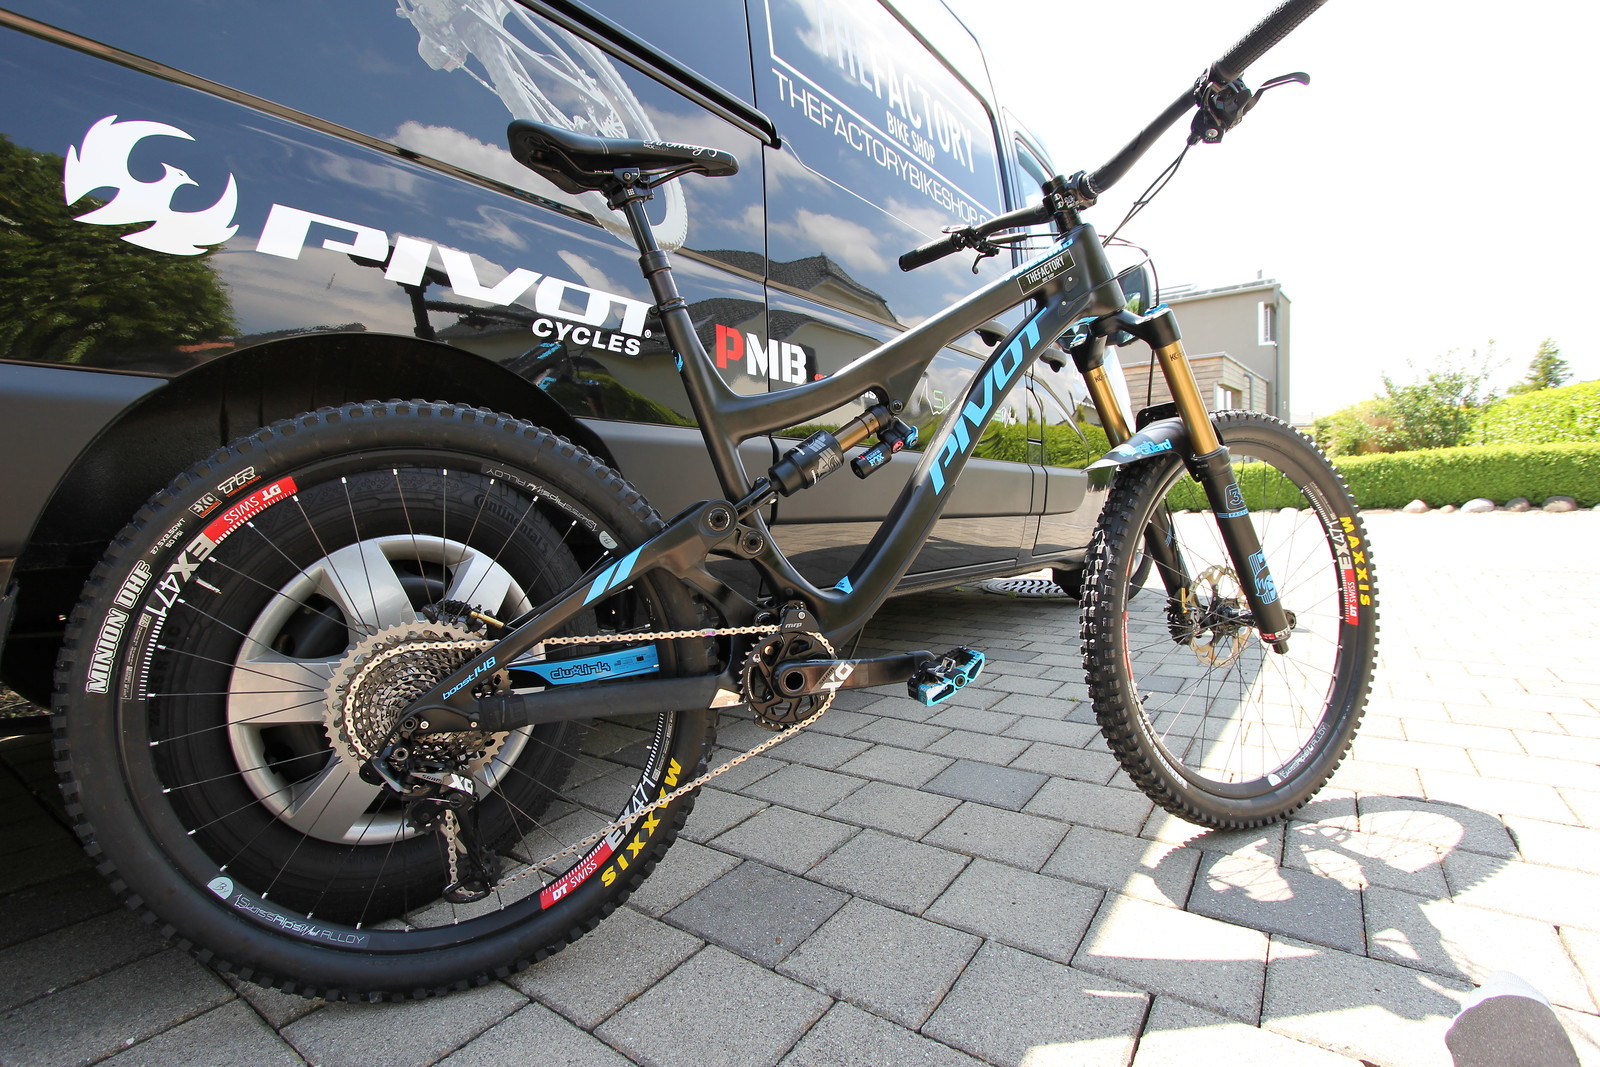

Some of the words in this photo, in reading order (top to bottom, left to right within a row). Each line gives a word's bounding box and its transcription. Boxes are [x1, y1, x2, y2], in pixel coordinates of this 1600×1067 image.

[886, 110, 911, 146] BIKE
[911, 130, 936, 165] SHOP
[256, 203, 656, 337] PIVOT
[1025, 255, 1065, 284] THEFACTORY
[531, 318, 641, 356] CYCLES
[715, 323, 808, 385] PMB
[928, 306, 1048, 496] PIVOT
[217, 466, 256, 494] TR
[262, 484, 282, 502] DT
[486, 468, 526, 488] ALLOY
[193, 493, 218, 515] EXO
[223, 496, 260, 526] SWISS
[172, 530, 184, 541] PSI
[1327, 519, 1353, 570] EX471
[145, 533, 218, 617] EX471
[1339, 516, 1371, 607] MAXXIS
[1346, 581, 1356, 604] SWISS
[1349, 604, 1358, 617] DT
[86, 608, 130, 695] MINION
[113, 560, 153, 609] DHF
[601, 757, 682, 888] MAXXIS
[552, 882, 568, 901] DT
[569, 858, 599, 888] SWISS
[320, 929, 365, 945] ALLOY
